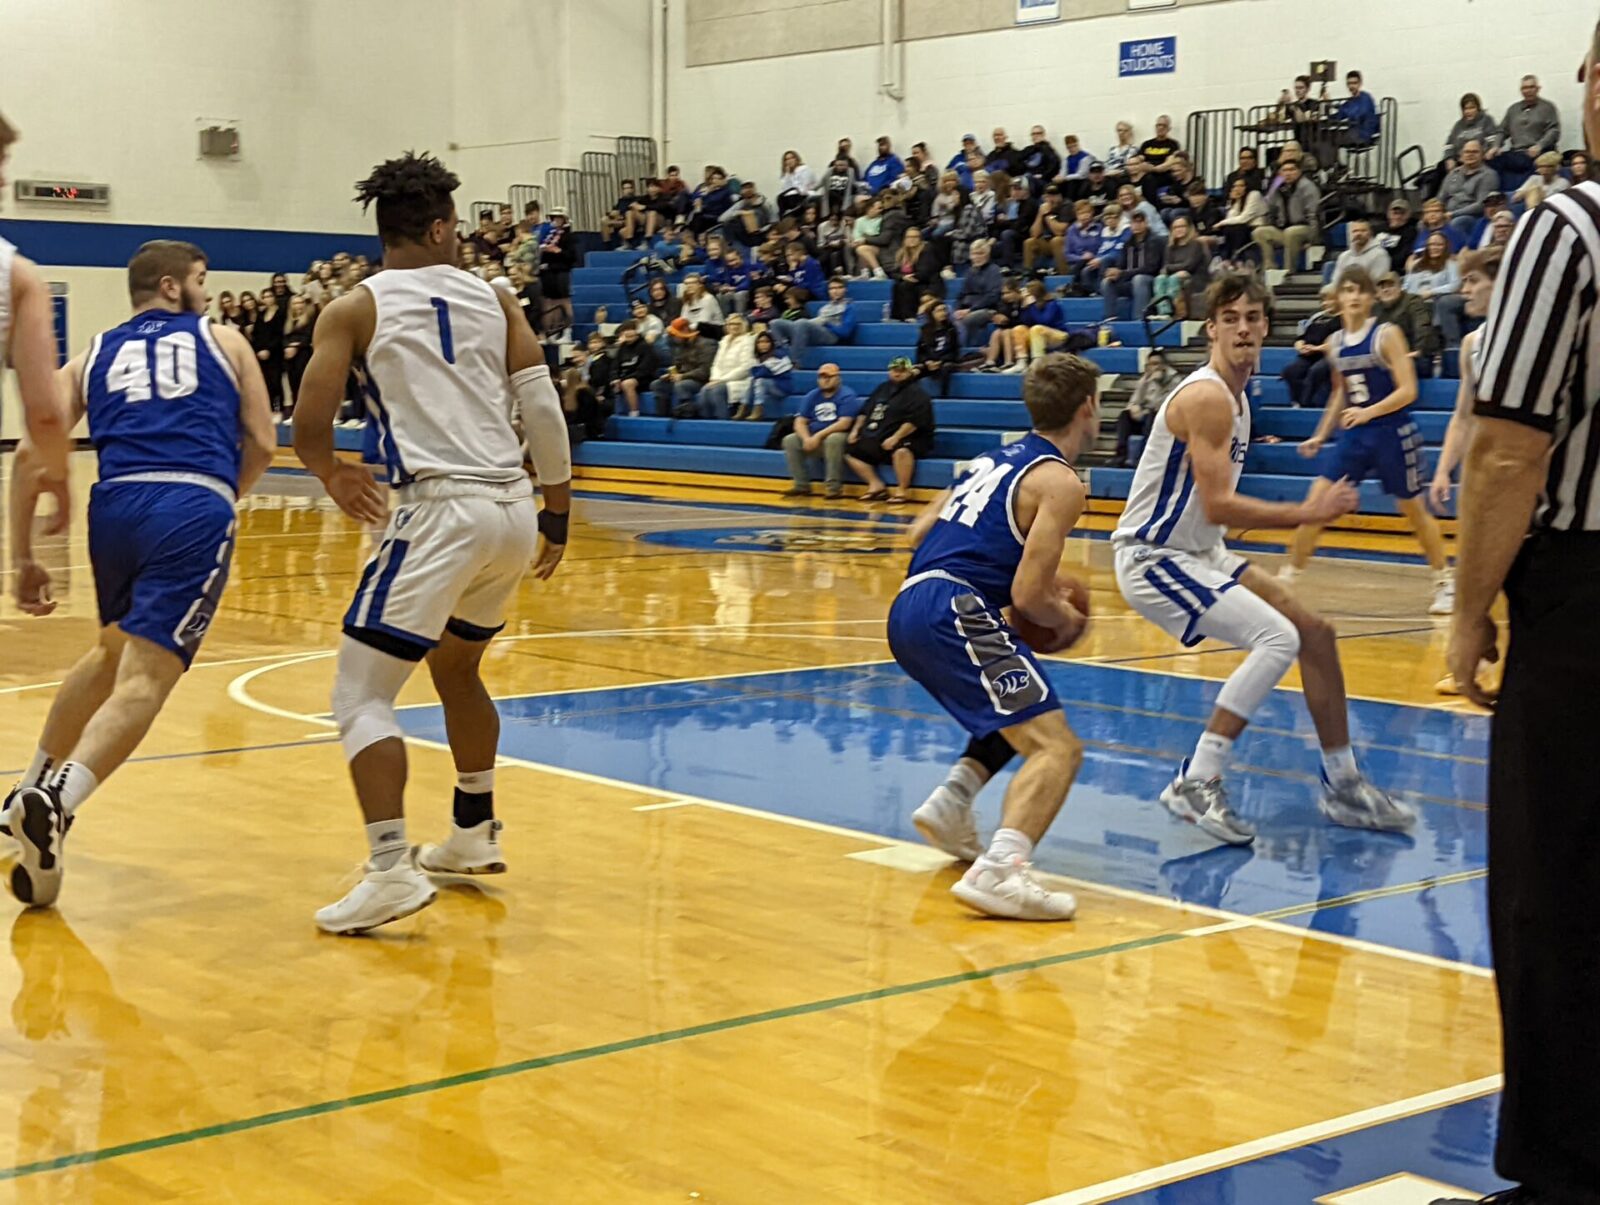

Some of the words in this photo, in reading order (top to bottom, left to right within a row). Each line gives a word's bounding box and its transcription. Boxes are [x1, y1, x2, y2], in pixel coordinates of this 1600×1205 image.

[1120, 55, 1175, 73] STUDENTS
[1130, 41, 1165, 57] HOME
[430, 296, 456, 365] 1
[105, 330, 199, 403] 40
[1346, 373, 1370, 404] 5
[938, 456, 1014, 528] 24
